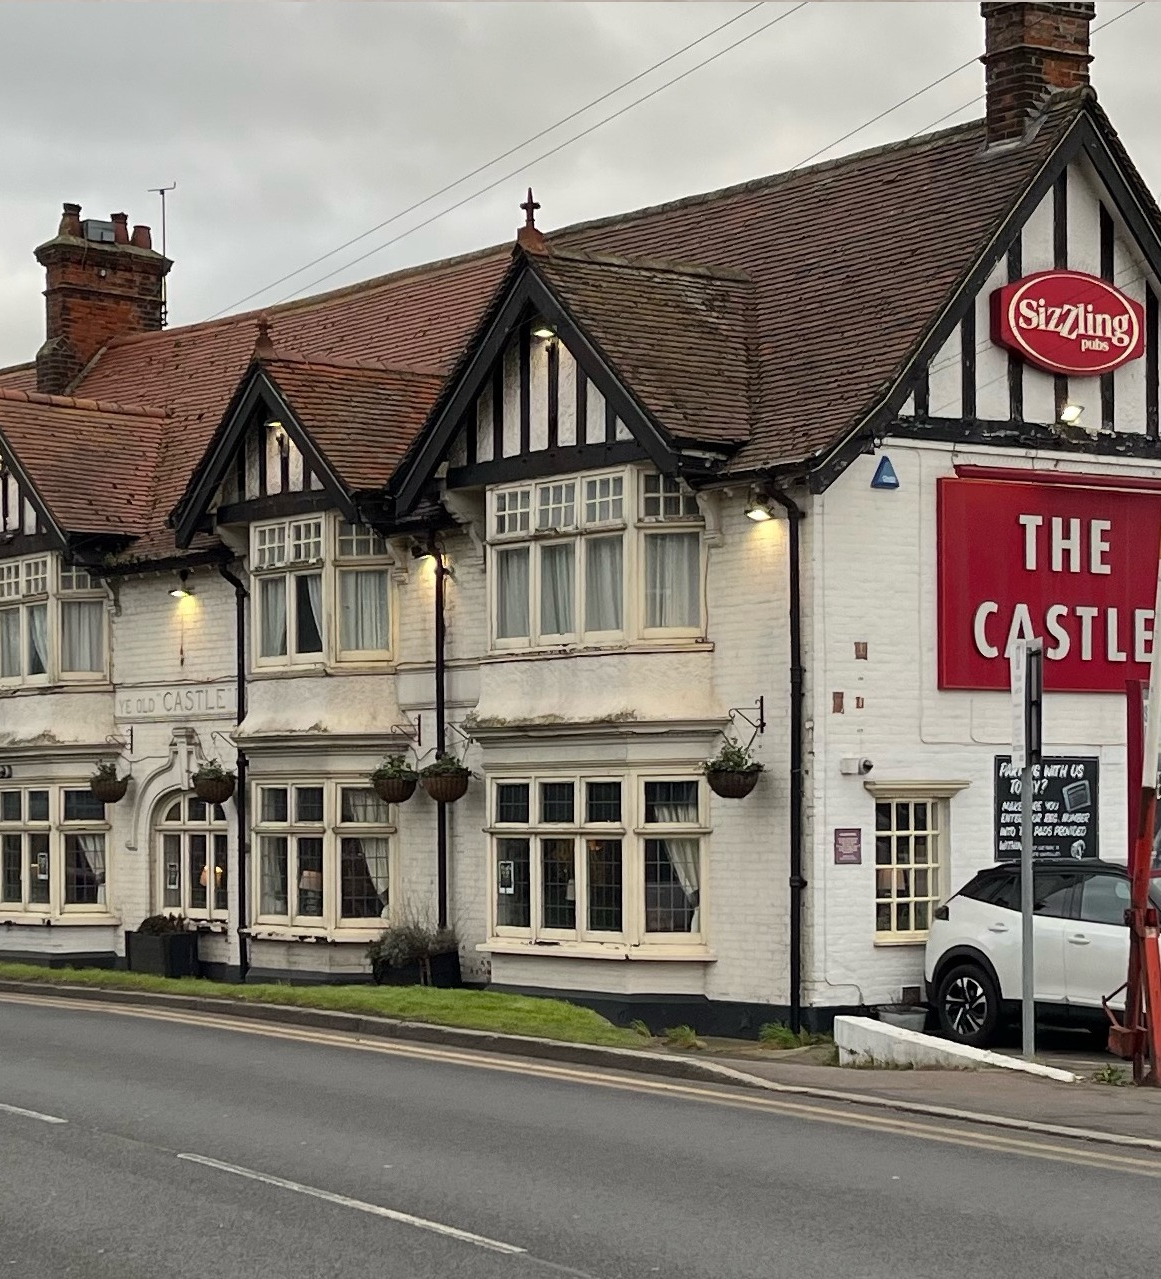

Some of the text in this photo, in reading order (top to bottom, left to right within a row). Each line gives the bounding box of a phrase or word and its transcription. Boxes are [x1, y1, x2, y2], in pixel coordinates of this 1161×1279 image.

[1081, 338, 1109, 352] pubs
[1019, 515, 1111, 574] THE
[974, 601, 1155, 662] CASTLE
[137, 698, 155, 713] OLD
[1044, 764, 1069, 778] WITH
[1070, 764, 1085, 779] US
